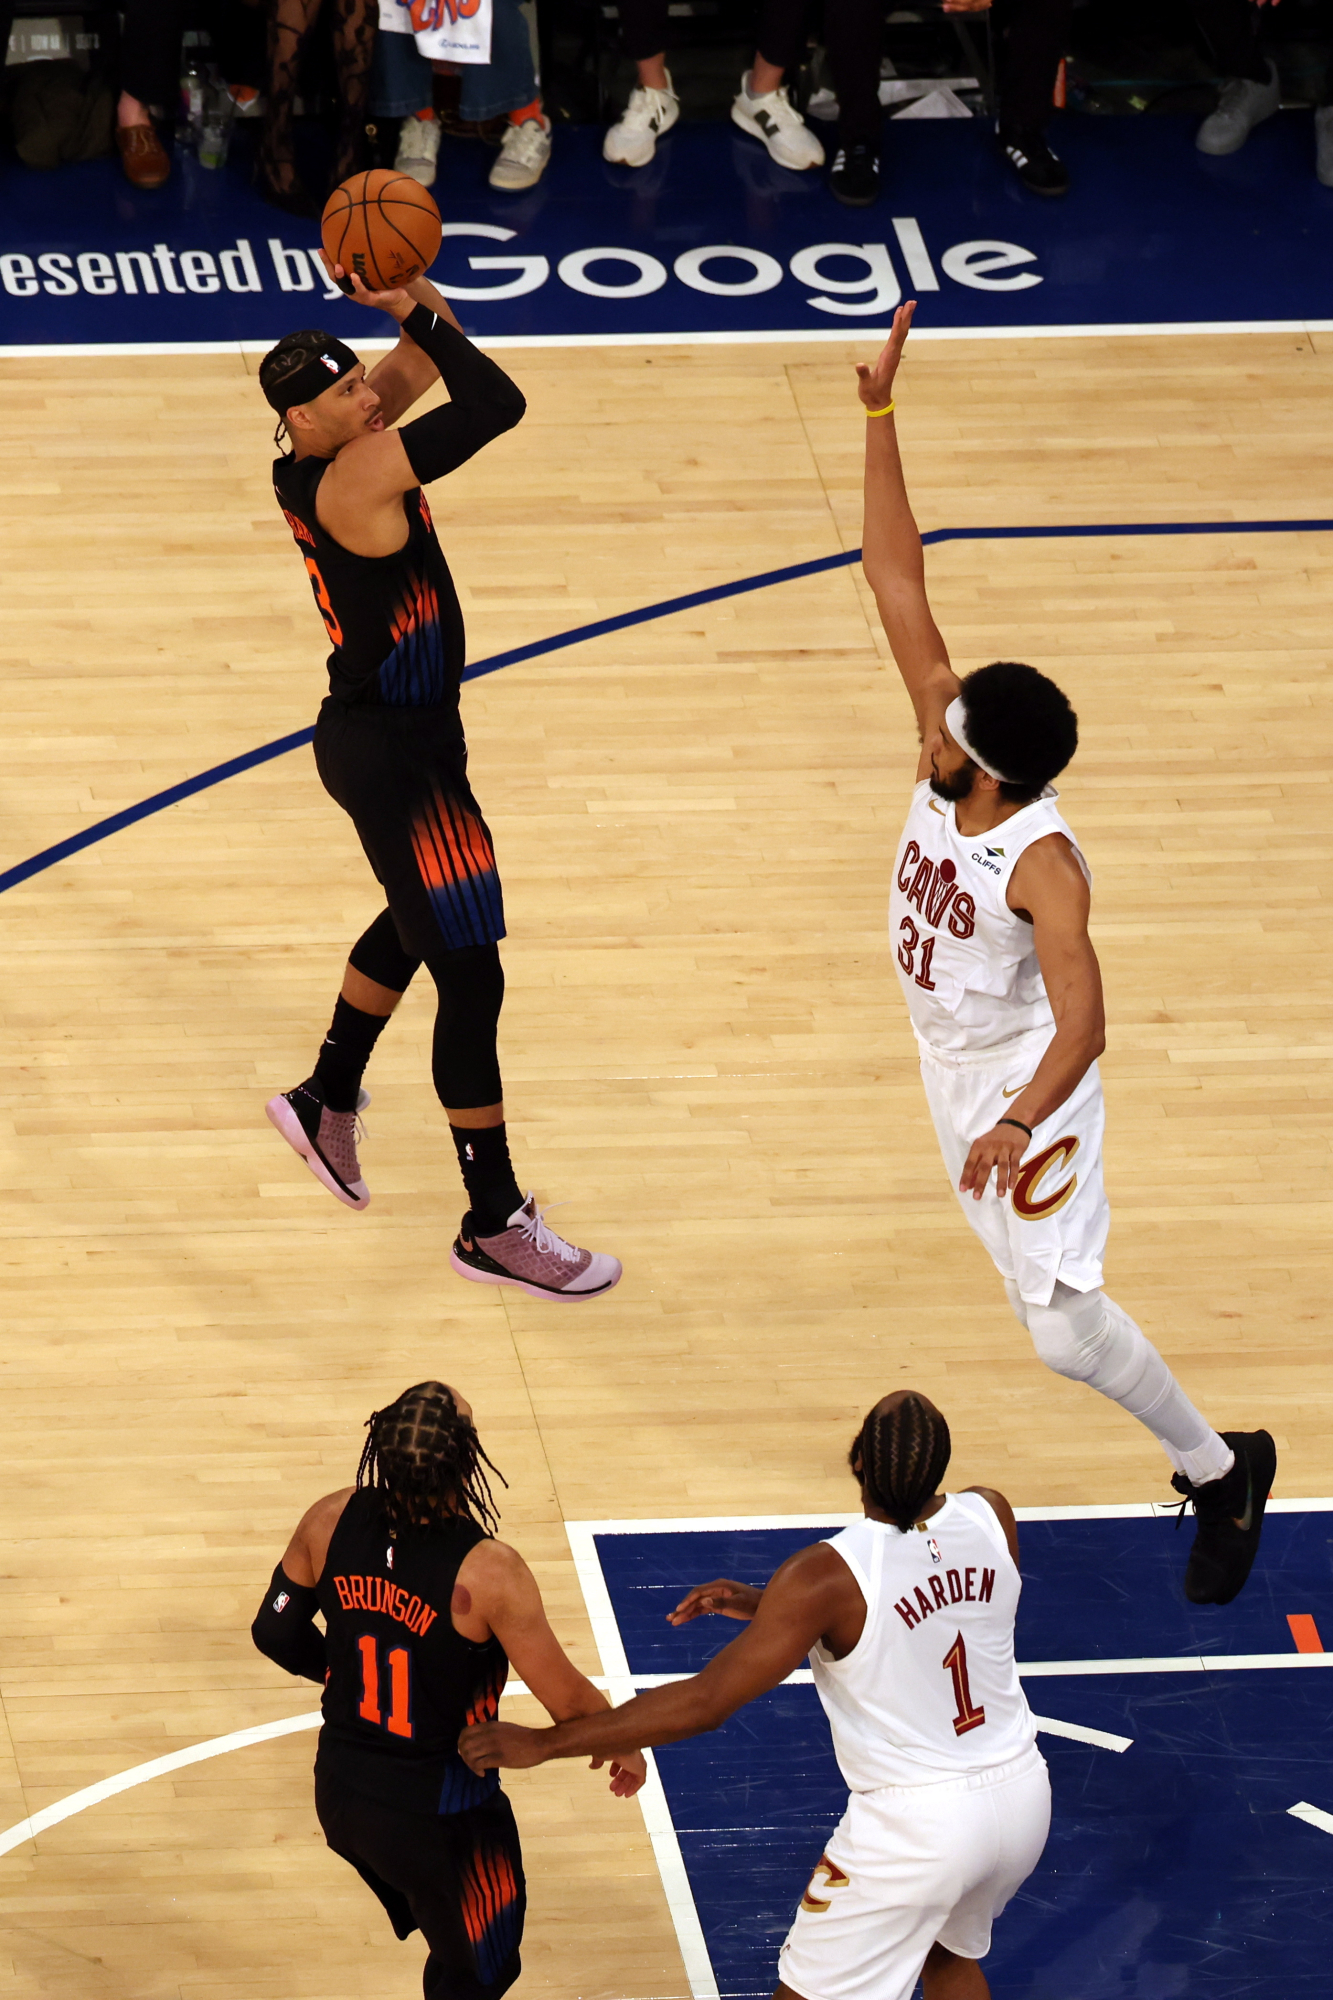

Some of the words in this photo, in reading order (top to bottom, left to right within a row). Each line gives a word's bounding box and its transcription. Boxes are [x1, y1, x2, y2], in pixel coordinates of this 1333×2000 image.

[0, 239, 263, 296] esented
[268, 238, 346, 300] by
[424, 218, 1044, 316] Google
[897, 840, 976, 940] CAVS
[971, 852, 1002, 876] CLIFFS
[897, 915, 936, 991] 31
[333, 1575, 438, 1637] BRUNSON
[893, 1567, 996, 1631] HARDEN
[356, 1632, 414, 1740] 11
[943, 1629, 986, 1737] 1
